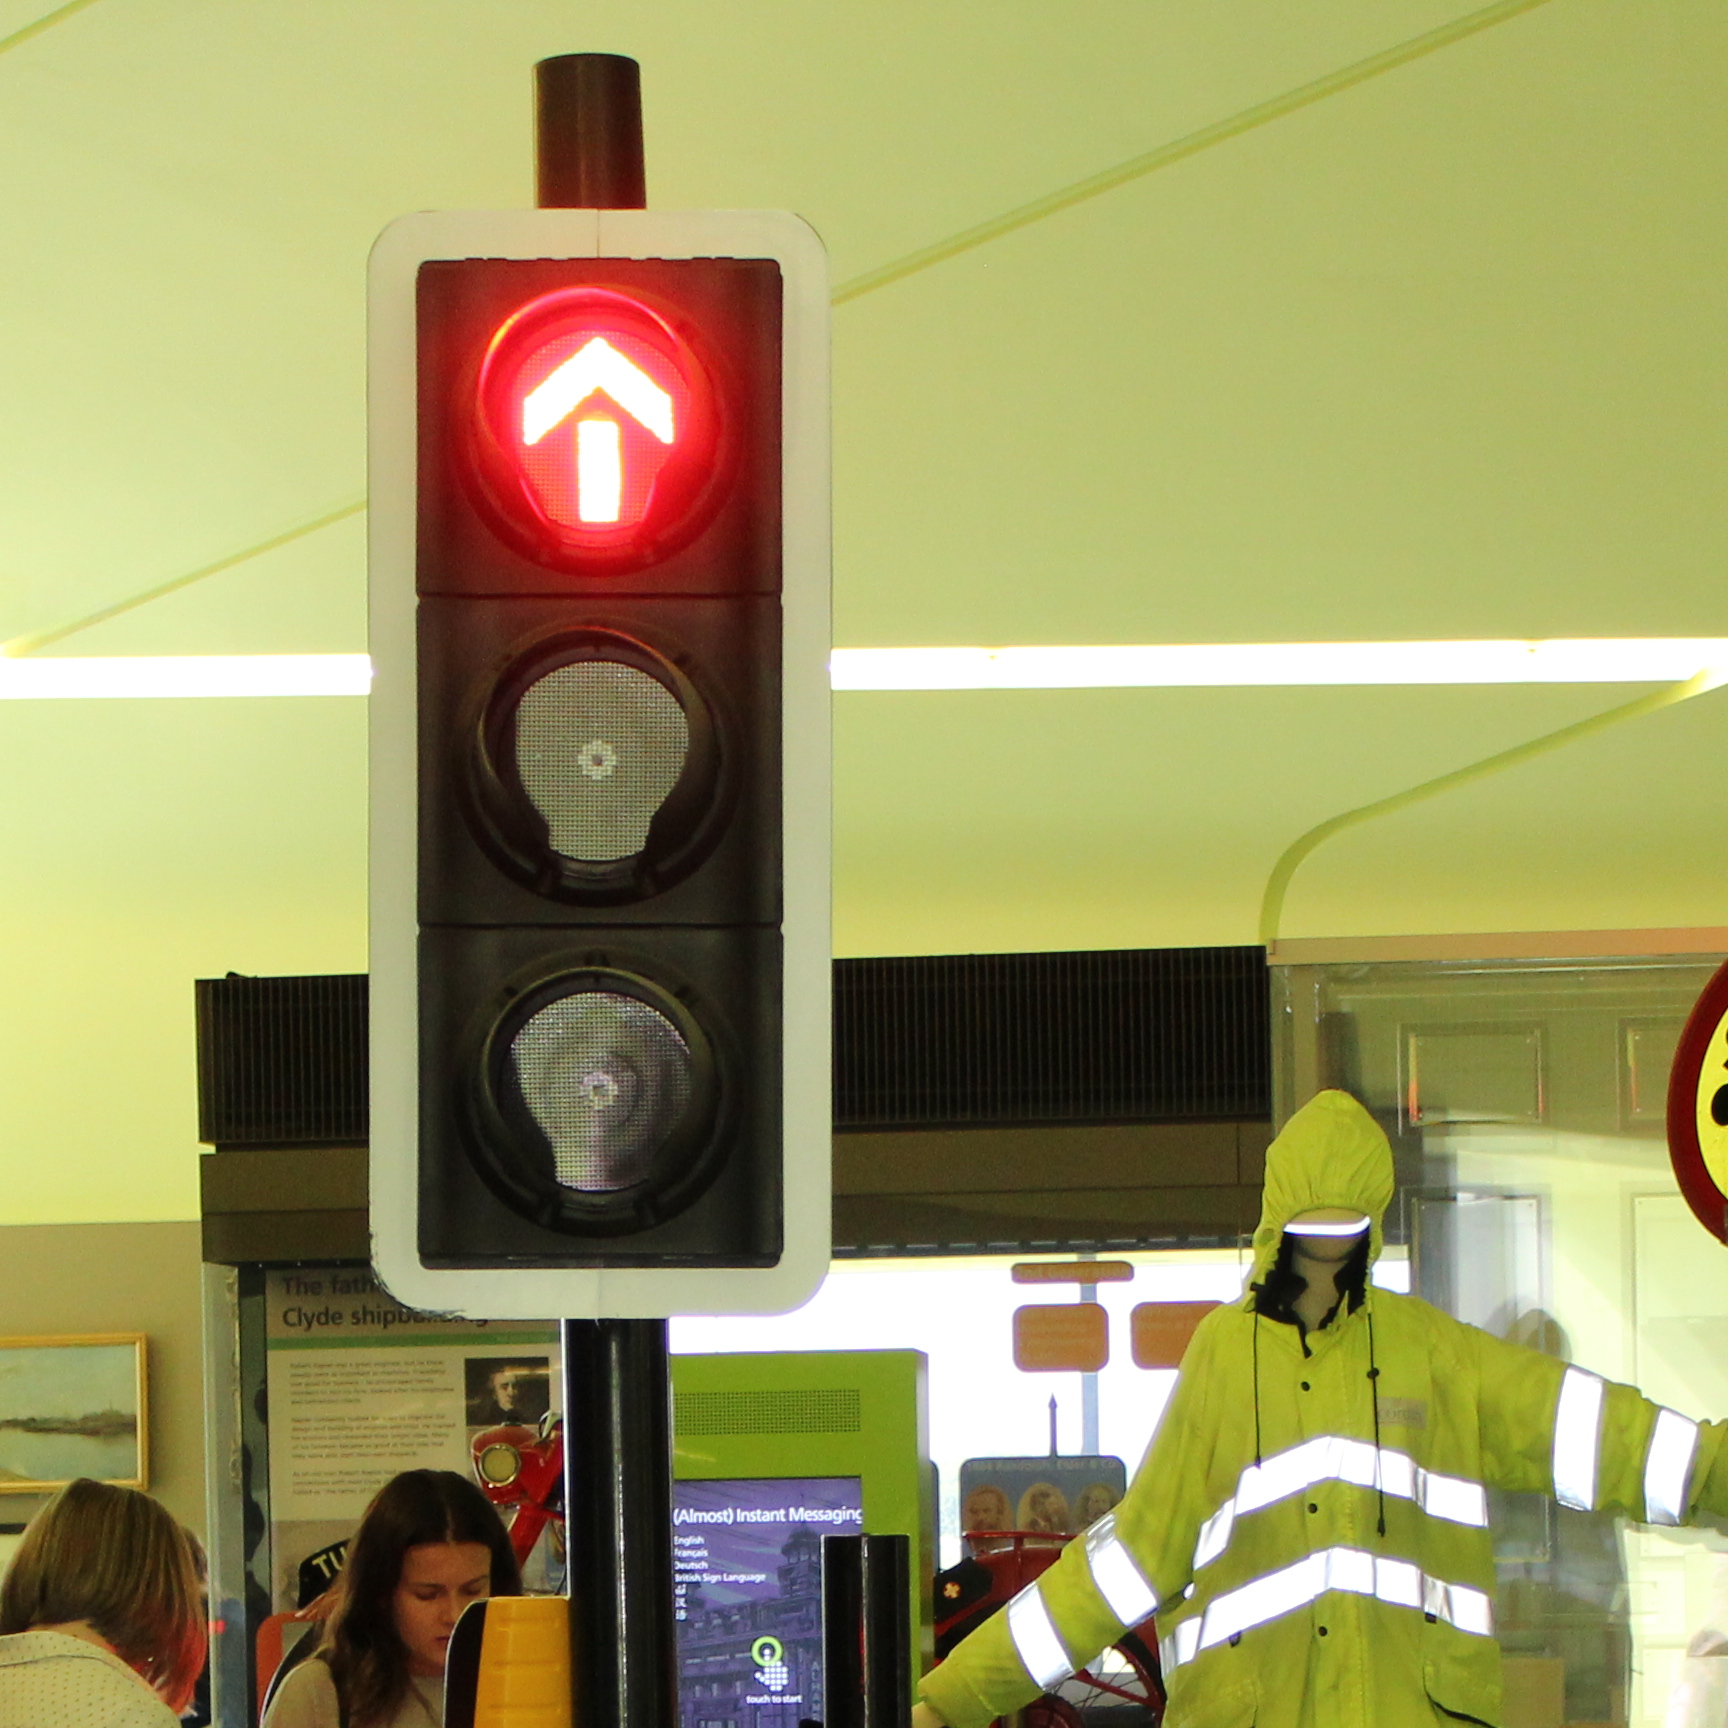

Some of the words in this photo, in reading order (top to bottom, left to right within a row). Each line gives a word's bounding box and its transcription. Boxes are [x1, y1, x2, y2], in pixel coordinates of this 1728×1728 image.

[282, 1276, 321, 1295] The
[332, 1275, 376, 1294] fath
[282, 1307, 343, 1331] Clyde
[673, 1507, 734, 1525] (Almost)
[736, 1507, 786, 1523] Instant
[789, 1505, 863, 1525] Messaging
[702, 1573, 722, 1584] Sign
[723, 1573, 767, 1584] Language
[745, 1694, 771, 1705] touch
[772, 1694, 781, 1704] to
[783, 1694, 803, 1704] start
